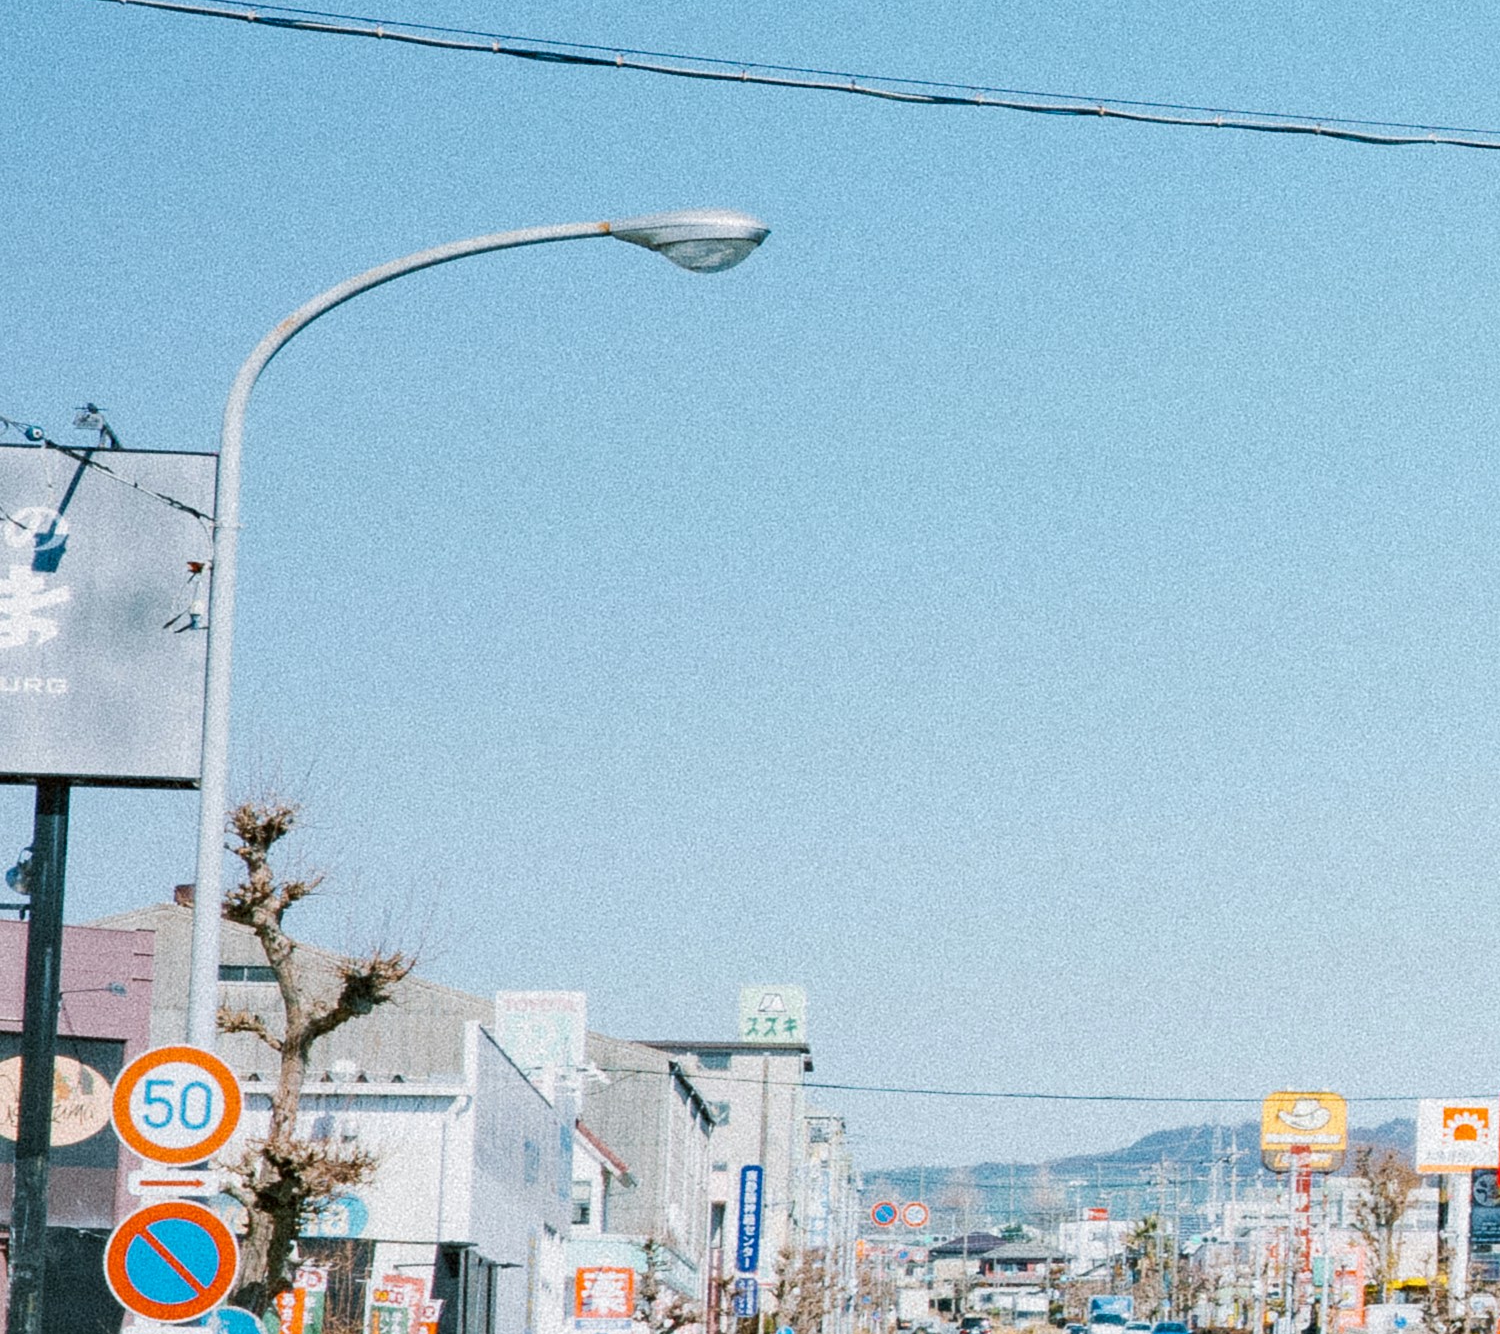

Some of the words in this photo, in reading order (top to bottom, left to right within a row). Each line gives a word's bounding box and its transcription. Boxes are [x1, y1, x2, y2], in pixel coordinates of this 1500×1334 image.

[746, 1017, 798, 1036] スズキ
[142, 1079, 213, 1129] 50
[582, 1272, 626, 1314] 薬
